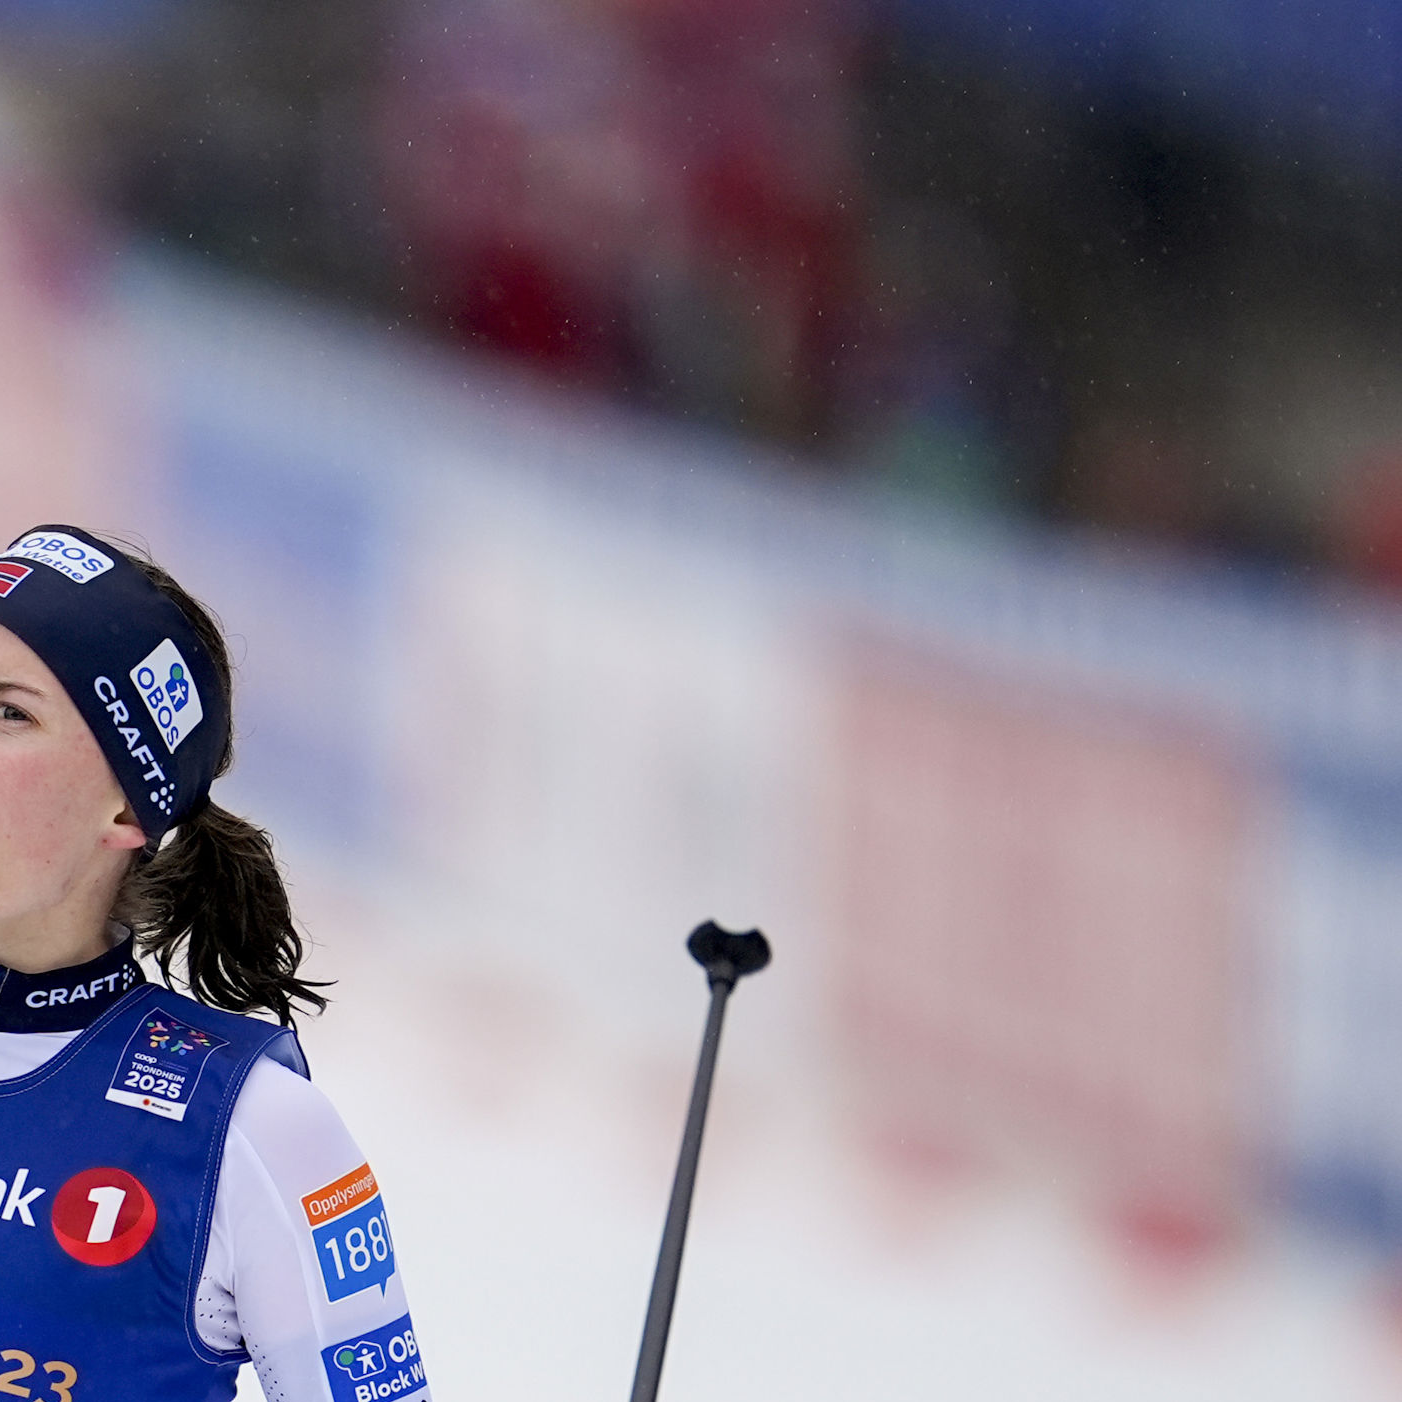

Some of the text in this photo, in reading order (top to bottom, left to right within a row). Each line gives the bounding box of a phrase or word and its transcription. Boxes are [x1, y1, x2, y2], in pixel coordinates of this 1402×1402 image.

[21, 537, 104, 572] OBOS
[94, 675, 166, 782] CRAFT
[137, 667, 179, 747] OBOS
[25, 972, 120, 1009] CRAFT
[124, 1070, 182, 1099] 2025
[131, 1061, 186, 1085] TRONDHEIM
[87, 1185, 127, 1244] 1
[324, 1209, 393, 1281] 1881
